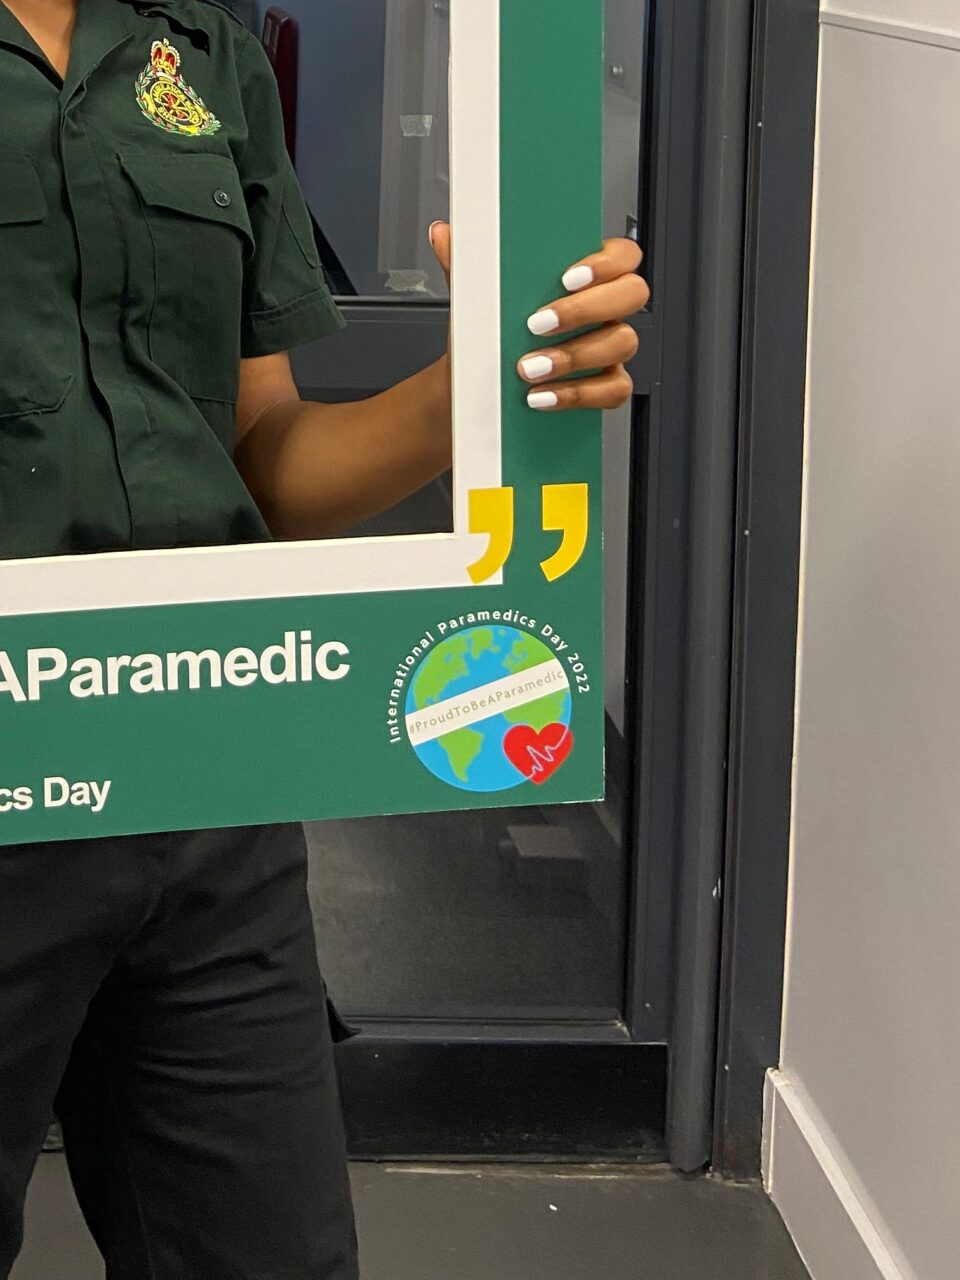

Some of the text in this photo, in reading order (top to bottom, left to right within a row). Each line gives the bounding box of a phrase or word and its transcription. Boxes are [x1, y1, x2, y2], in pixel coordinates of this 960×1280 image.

[387, 609, 590, 743] International Paramedics Day 2022
[409, 669, 564, 734] #ProudToBeAParamedic
[43, 776, 112, 812] Day
